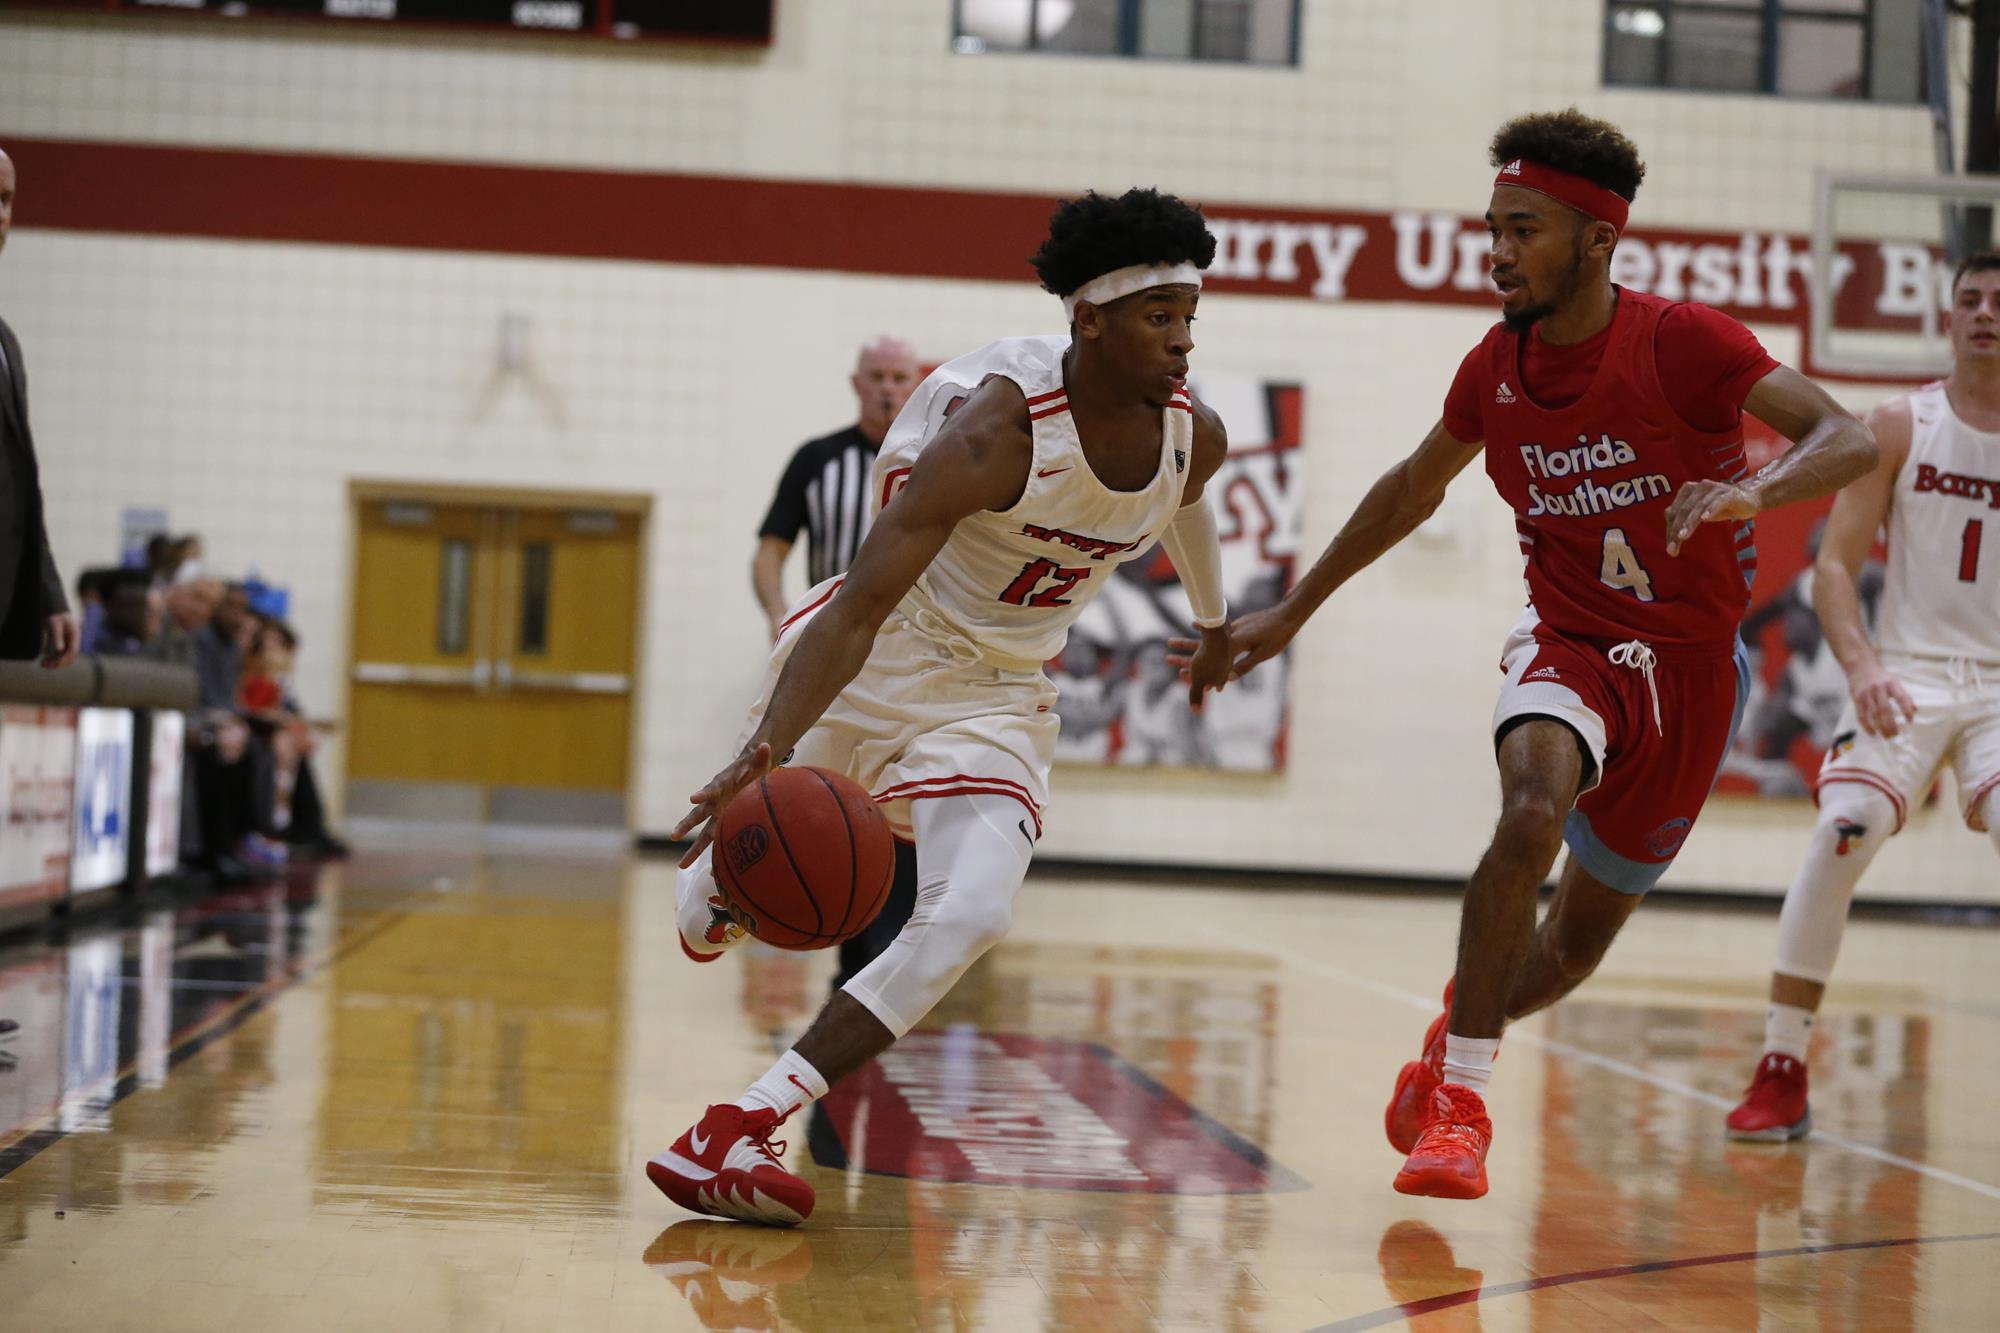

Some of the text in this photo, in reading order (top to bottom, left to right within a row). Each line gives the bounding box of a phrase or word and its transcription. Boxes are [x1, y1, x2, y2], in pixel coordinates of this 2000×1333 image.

[1203, 217, 1368, 298] rry
[1390, 211, 1854, 310] Unersity
[1518, 433, 1638, 480] Florida
[1527, 473, 1672, 516] Southern
[1599, 527, 1655, 602] 4
[1958, 518, 1983, 583] 1
[998, 556, 1092, 608] 12
